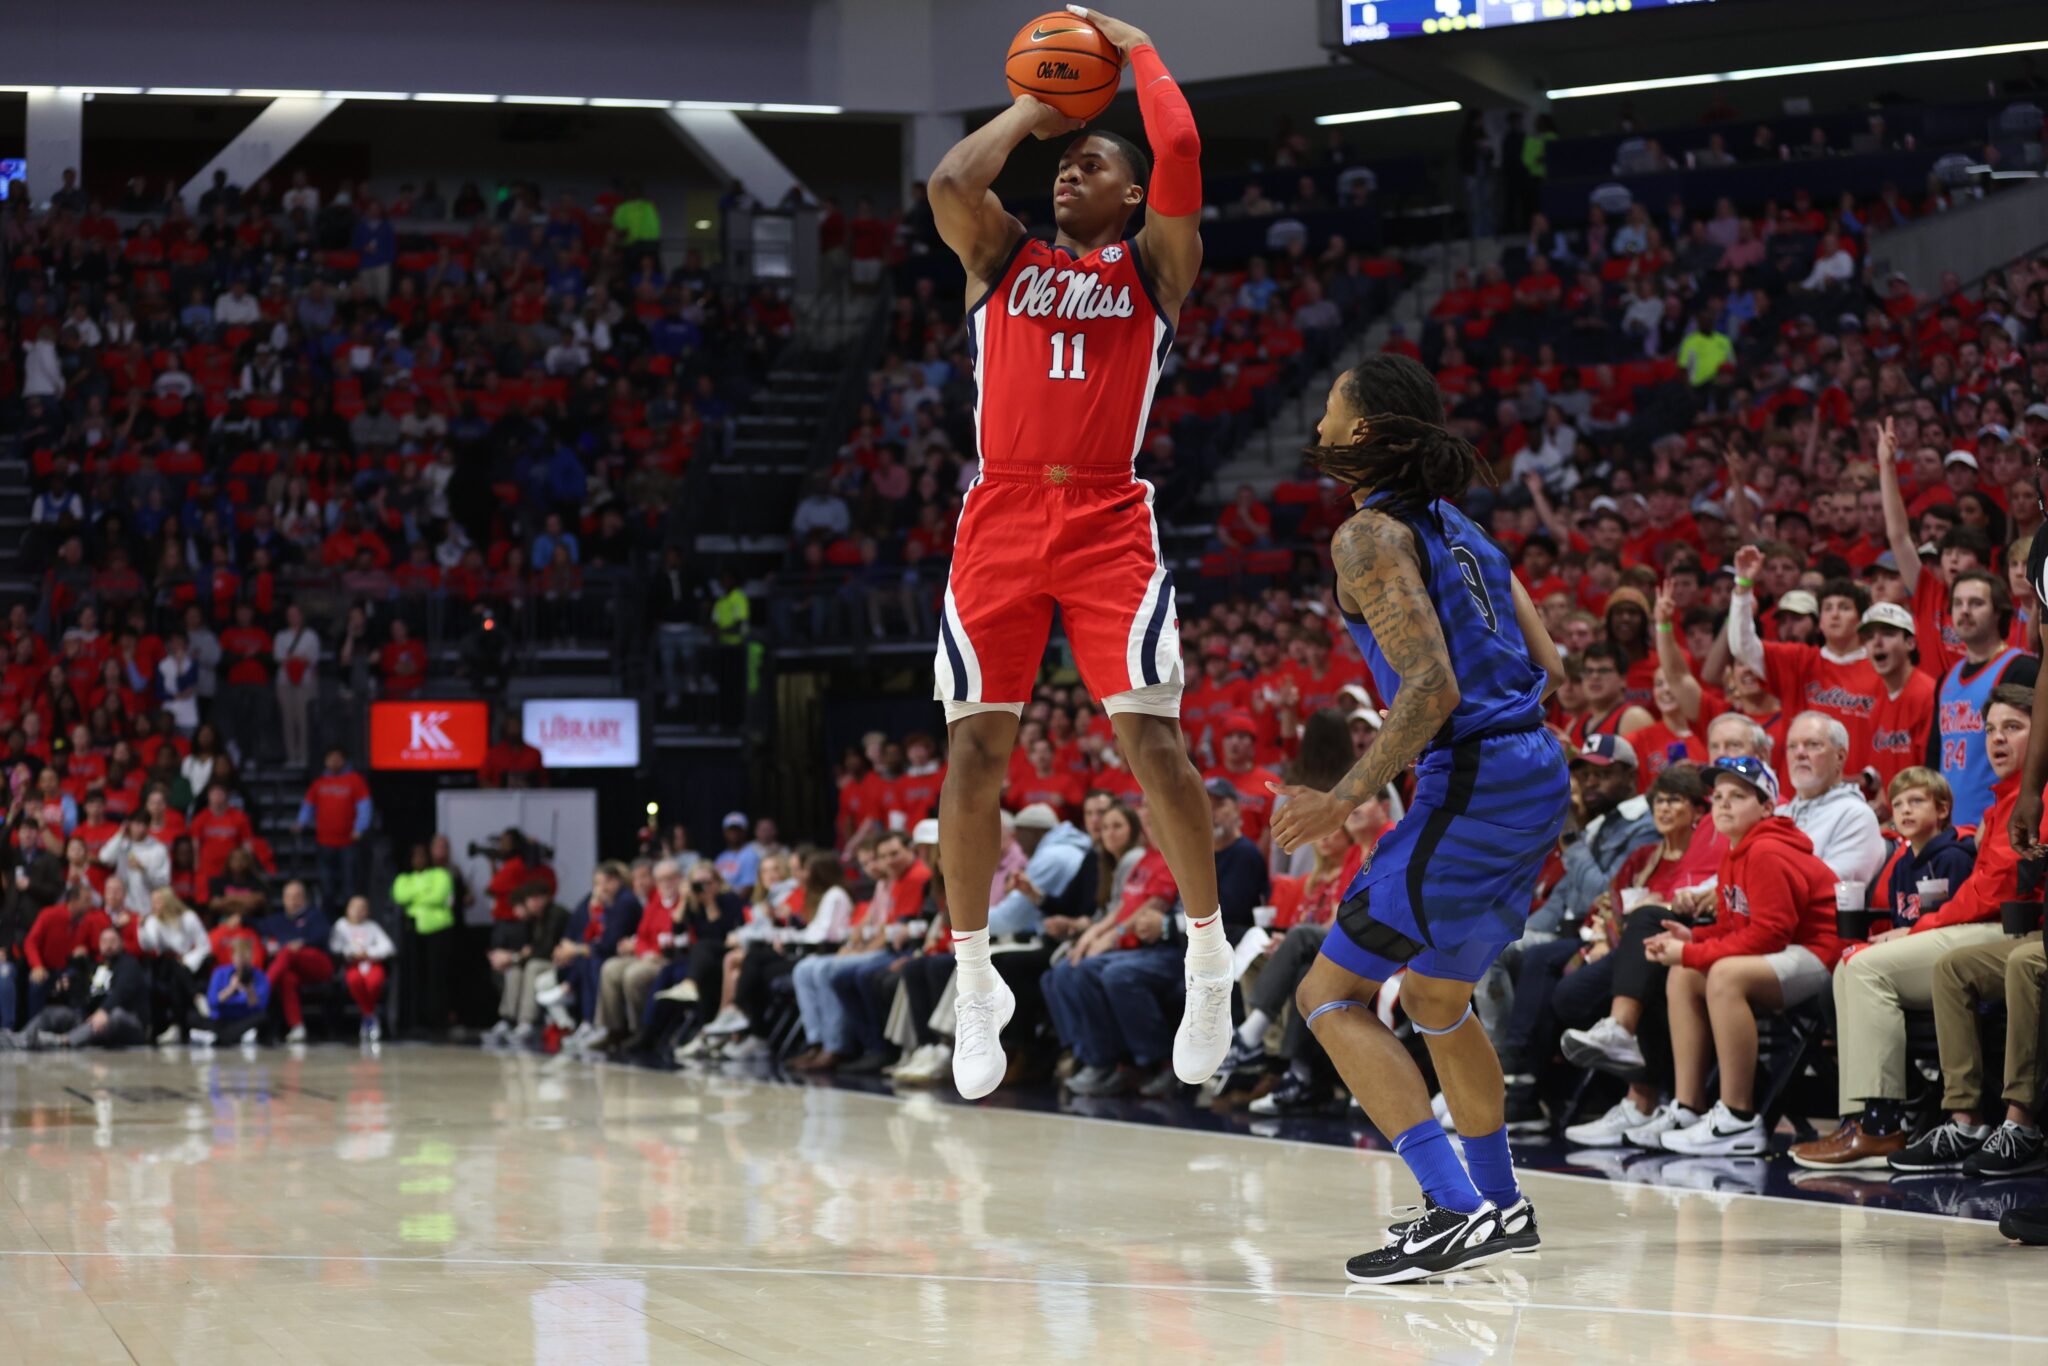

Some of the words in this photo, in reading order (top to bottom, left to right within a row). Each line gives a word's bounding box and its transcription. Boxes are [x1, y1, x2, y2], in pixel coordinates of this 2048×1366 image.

[1036, 61, 1054, 80] Ole
[1053, 62, 1080, 81] Miss
[1007, 264, 1057, 318] Ole
[1056, 269, 1135, 321] Miss
[1048, 331, 1086, 380] 11
